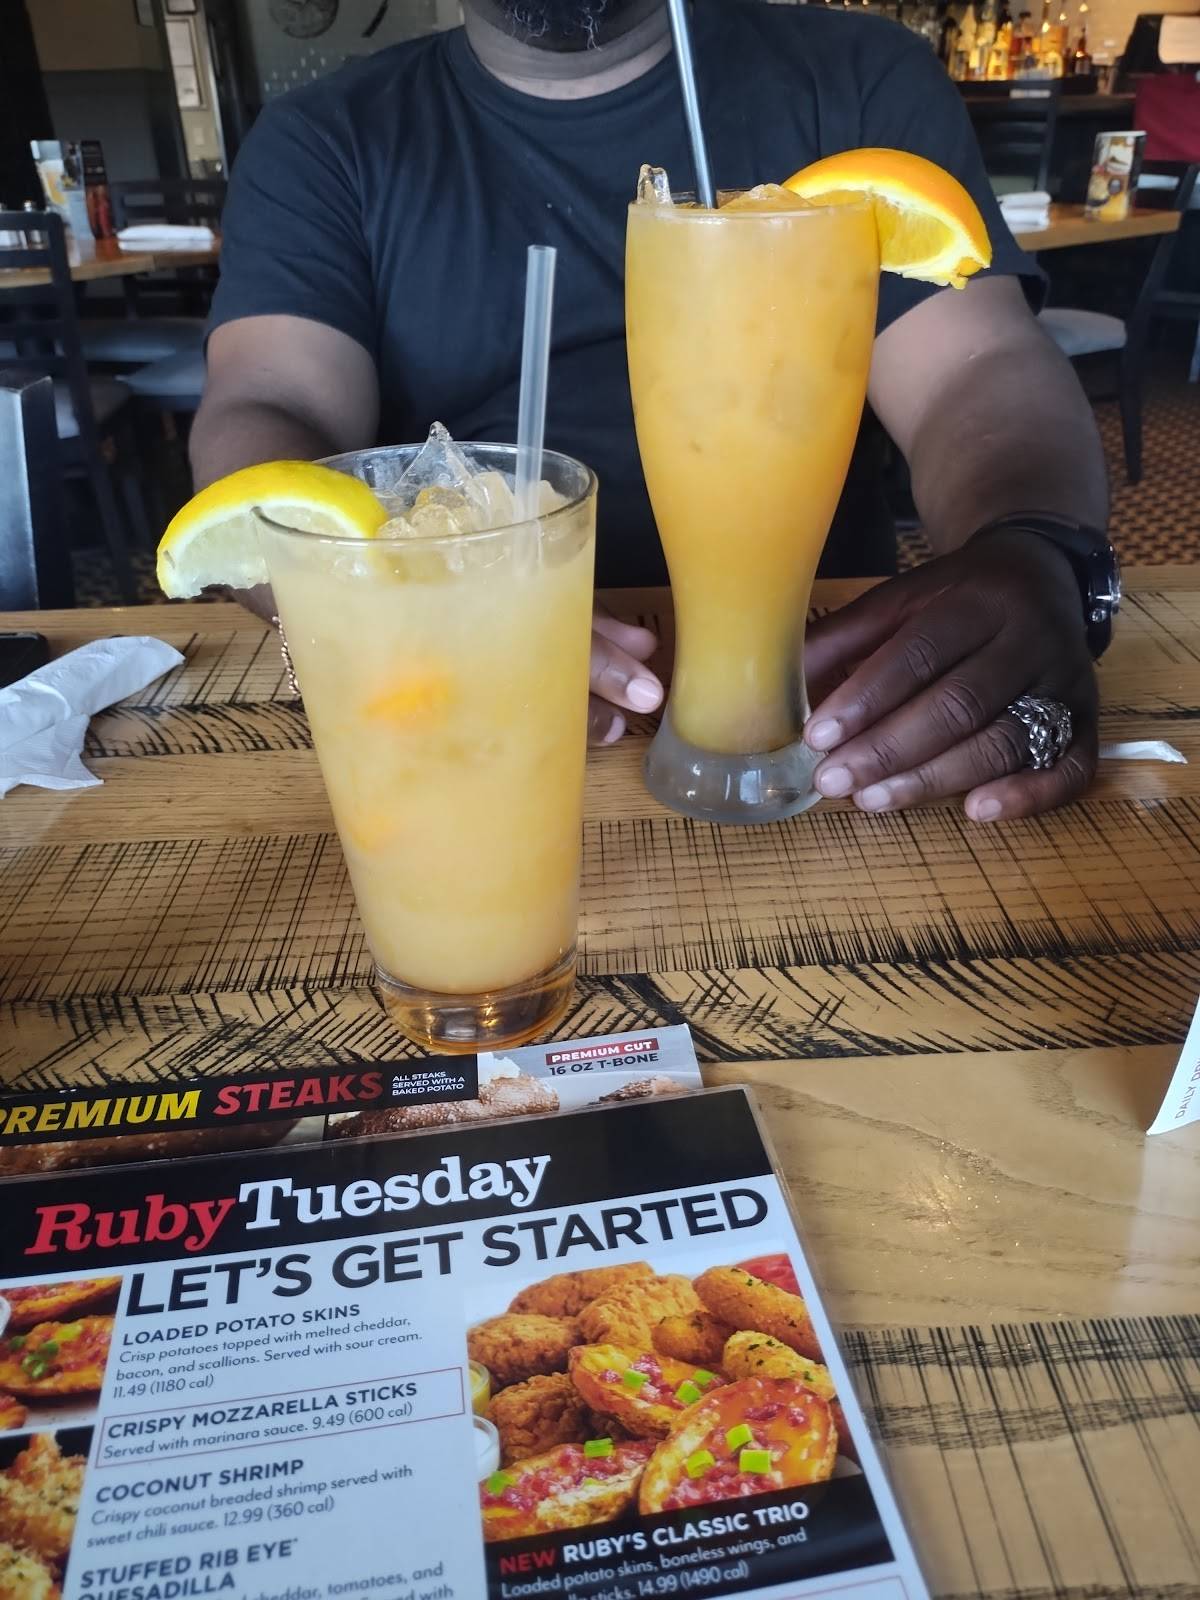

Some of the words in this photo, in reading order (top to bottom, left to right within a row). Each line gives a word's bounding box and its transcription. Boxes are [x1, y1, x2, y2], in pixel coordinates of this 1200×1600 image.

[549, 1065, 567, 1076] 16
[570, 1061, 594, 1073] OZ
[596, 1052, 659, 1069] T-BONE
[551, 1045, 620, 1063] PREMIUM
[623, 1041, 653, 1052] CUT
[392, 1080, 430, 1089] SERVED
[431, 1077, 456, 1085] WITH
[392, 1087, 425, 1096] BAKED
[427, 1083, 465, 1093] POTATO
[411, 1071, 446, 1081] STEAKS
[0, 1090, 201, 1135] REMIUM
[212, 1071, 384, 1116] STEAKS
[1175, 1086, 1197, 1119] DAILY
[238, 1154, 552, 1231] Tuesday
[331, 1230, 464, 1290] GET
[481, 1187, 768, 1267] STARTED
[119, 1350, 156, 1364] Crisp
[158, 1344, 219, 1361] potatoes
[222, 1333, 271, 1351] topped
[273, 1329, 302, 1344] with
[305, 1323, 350, 1340] melted
[353, 1316, 411, 1333] cheddar,
[122, 1324, 208, 1346] LOADED
[215, 1312, 295, 1335] POTATO
[302, 1304, 361, 1323] SKINS
[116, 1368, 164, 1381] bacon,
[168, 1360, 195, 1375] and
[198, 1355, 260, 1370] scallions.
[264, 1345, 311, 1362] Served
[313, 1341, 342, 1355] with
[345, 1338, 374, 1351] sour
[377, 1332, 423, 1346] cream.
[113, 1382, 147, 1399] 11.49
[150, 1378, 186, 1396] (1180
[188, 1373, 214, 1389] cal)
[103, 1440, 155, 1459] Served
[158, 1436, 189, 1451] with
[193, 1428, 260, 1447] marinara
[263, 1423, 308, 1438] sauce.
[312, 1412, 345, 1430] 9.49
[349, 1406, 384, 1426] (600
[388, 1401, 413, 1418] cal)
[107, 1414, 186, 1439] CRISPY
[191, 1394, 339, 1428] MOZZARELLA
[345, 1382, 418, 1406] STICKS
[91, 1508, 141, 1526] Crispy
[144, 1499, 206, 1518] coconut
[210, 1484, 273, 1508] breaded
[276, 1481, 327, 1497] shrimp
[330, 1468, 378, 1489] served
[380, 1465, 413, 1481] with
[95, 1471, 213, 1504] COCONUT
[218, 1458, 305, 1486] SHRIMP
[86, 1531, 133, 1549] sweet
[136, 1522, 168, 1541] chili
[170, 1520, 218, 1537] sauce.
[223, 1506, 263, 1527] 12.99
[266, 1500, 305, 1522] (360
[307, 1495, 335, 1515] cal)
[499, 1547, 556, 1575] NEW
[651, 1513, 750, 1546] CLASSIC
[753, 1501, 809, 1526] TRIO
[79, 1555, 192, 1590] STUFFED
[198, 1548, 239, 1571] RIB
[327, 1571, 408, 1595] tomatoes,
[412, 1560, 444, 1582] and
[501, 1572, 561, 1598] Loaded
[563, 1567, 614, 1591] potato
[617, 1560, 658, 1577] skins,
[659, 1546, 725, 1569] boneless
[726, 1538, 776, 1555] wings,
[777, 1526, 808, 1547] and
[637, 1573, 678, 1597] 14.99
[679, 1565, 721, 1591] (1490
[723, 1559, 749, 1581] cal)
